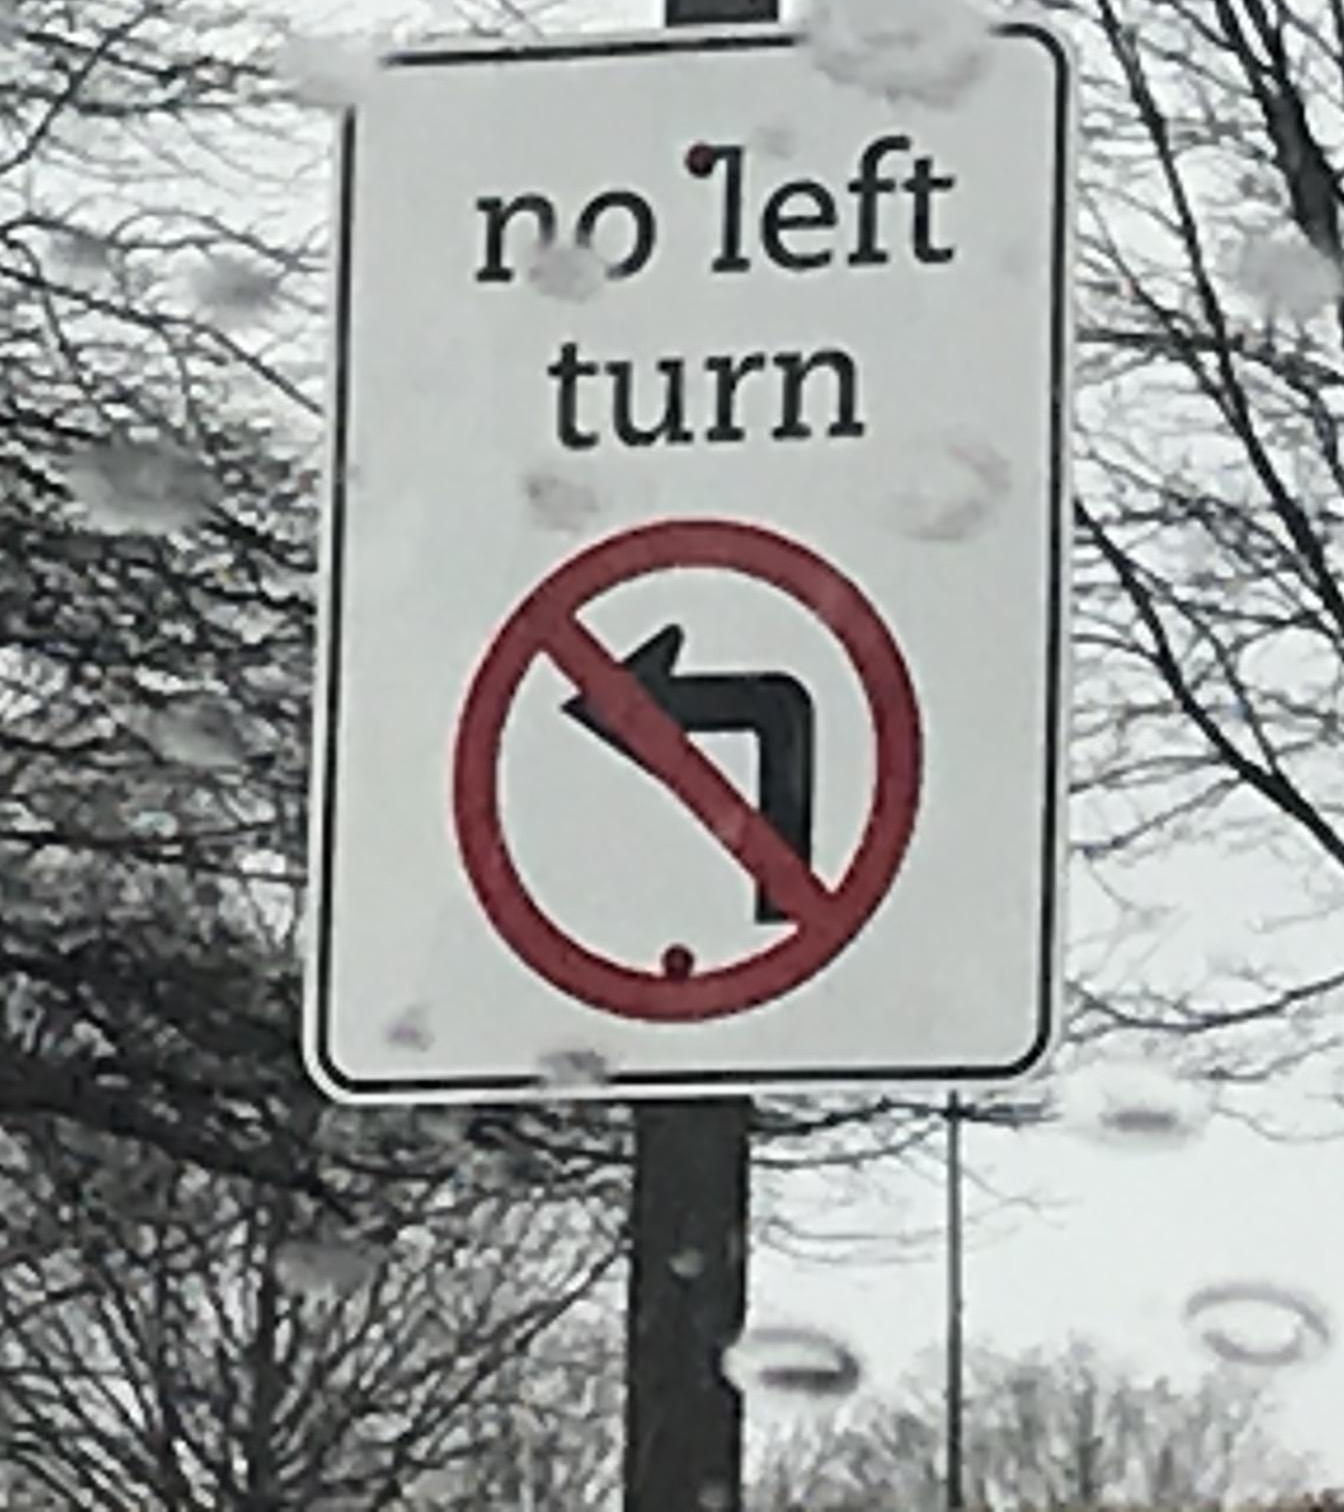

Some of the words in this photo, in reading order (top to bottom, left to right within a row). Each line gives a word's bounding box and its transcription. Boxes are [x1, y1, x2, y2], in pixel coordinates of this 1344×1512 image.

[474, 188, 657, 283] no
[706, 135, 957, 273] left
[546, 341, 866, 451] turn
